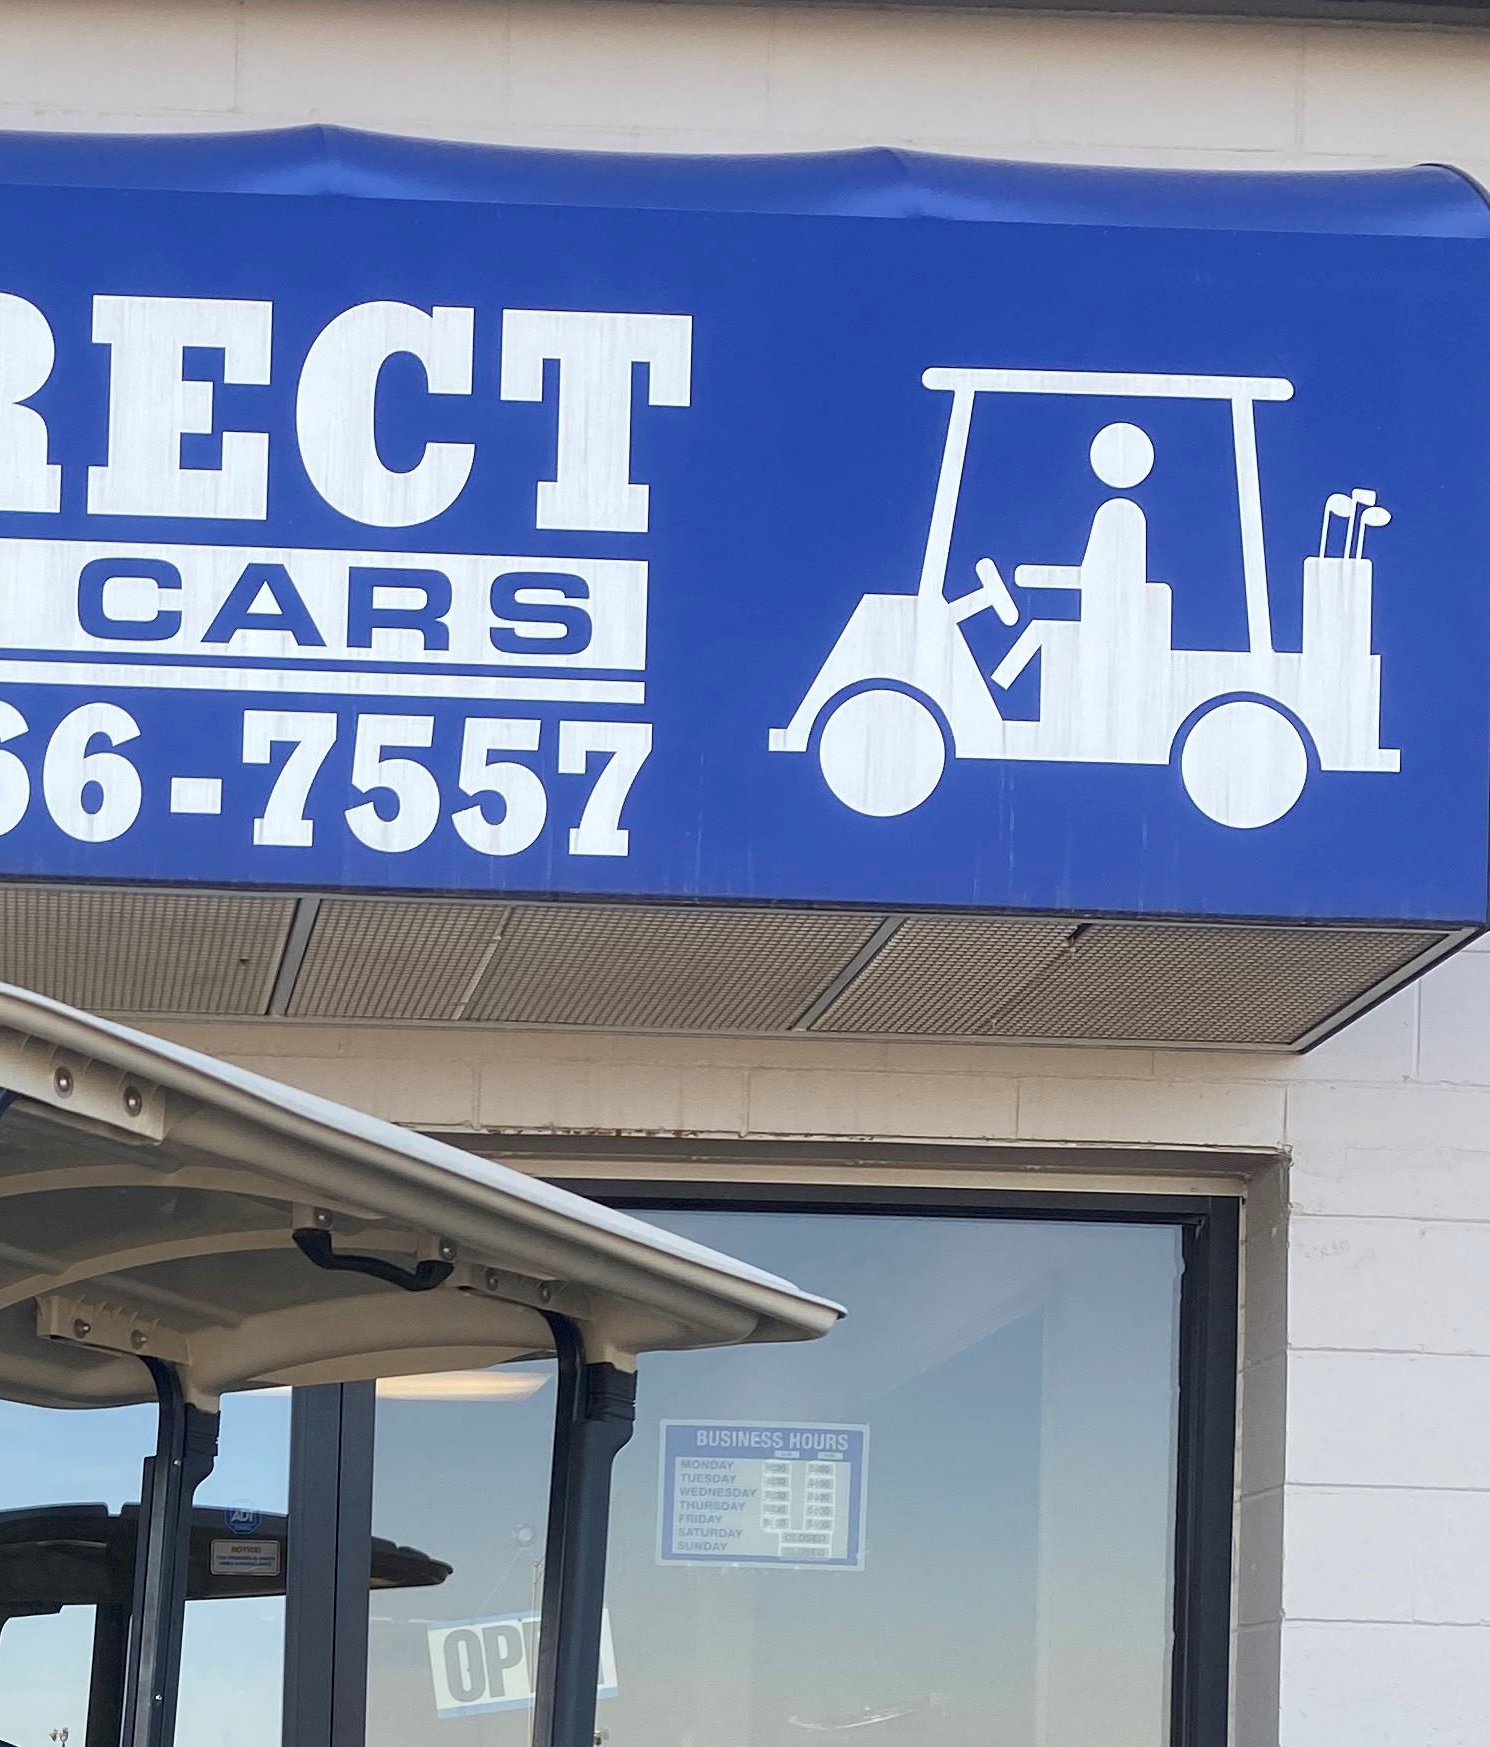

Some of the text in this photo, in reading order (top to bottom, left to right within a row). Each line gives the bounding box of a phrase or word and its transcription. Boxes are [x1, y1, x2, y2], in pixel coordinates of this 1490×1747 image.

[77, 557, 592, 655] CARS
[696, 1430, 849, 1451] BUSINESS HOURS
[680, 1460, 734, 1471] MONDAY
[680, 1473, 736, 1484] TUESDAY
[679, 1487, 757, 1498] WEDNESDAY
[679, 1500, 746, 1511] THURSDAY
[678, 1514, 722, 1524] FRIDAY
[678, 1528, 743, 1539] SATURDAY
[677, 1541, 727, 1552] SUNDAY
[443, 1621, 604, 1703] OP
